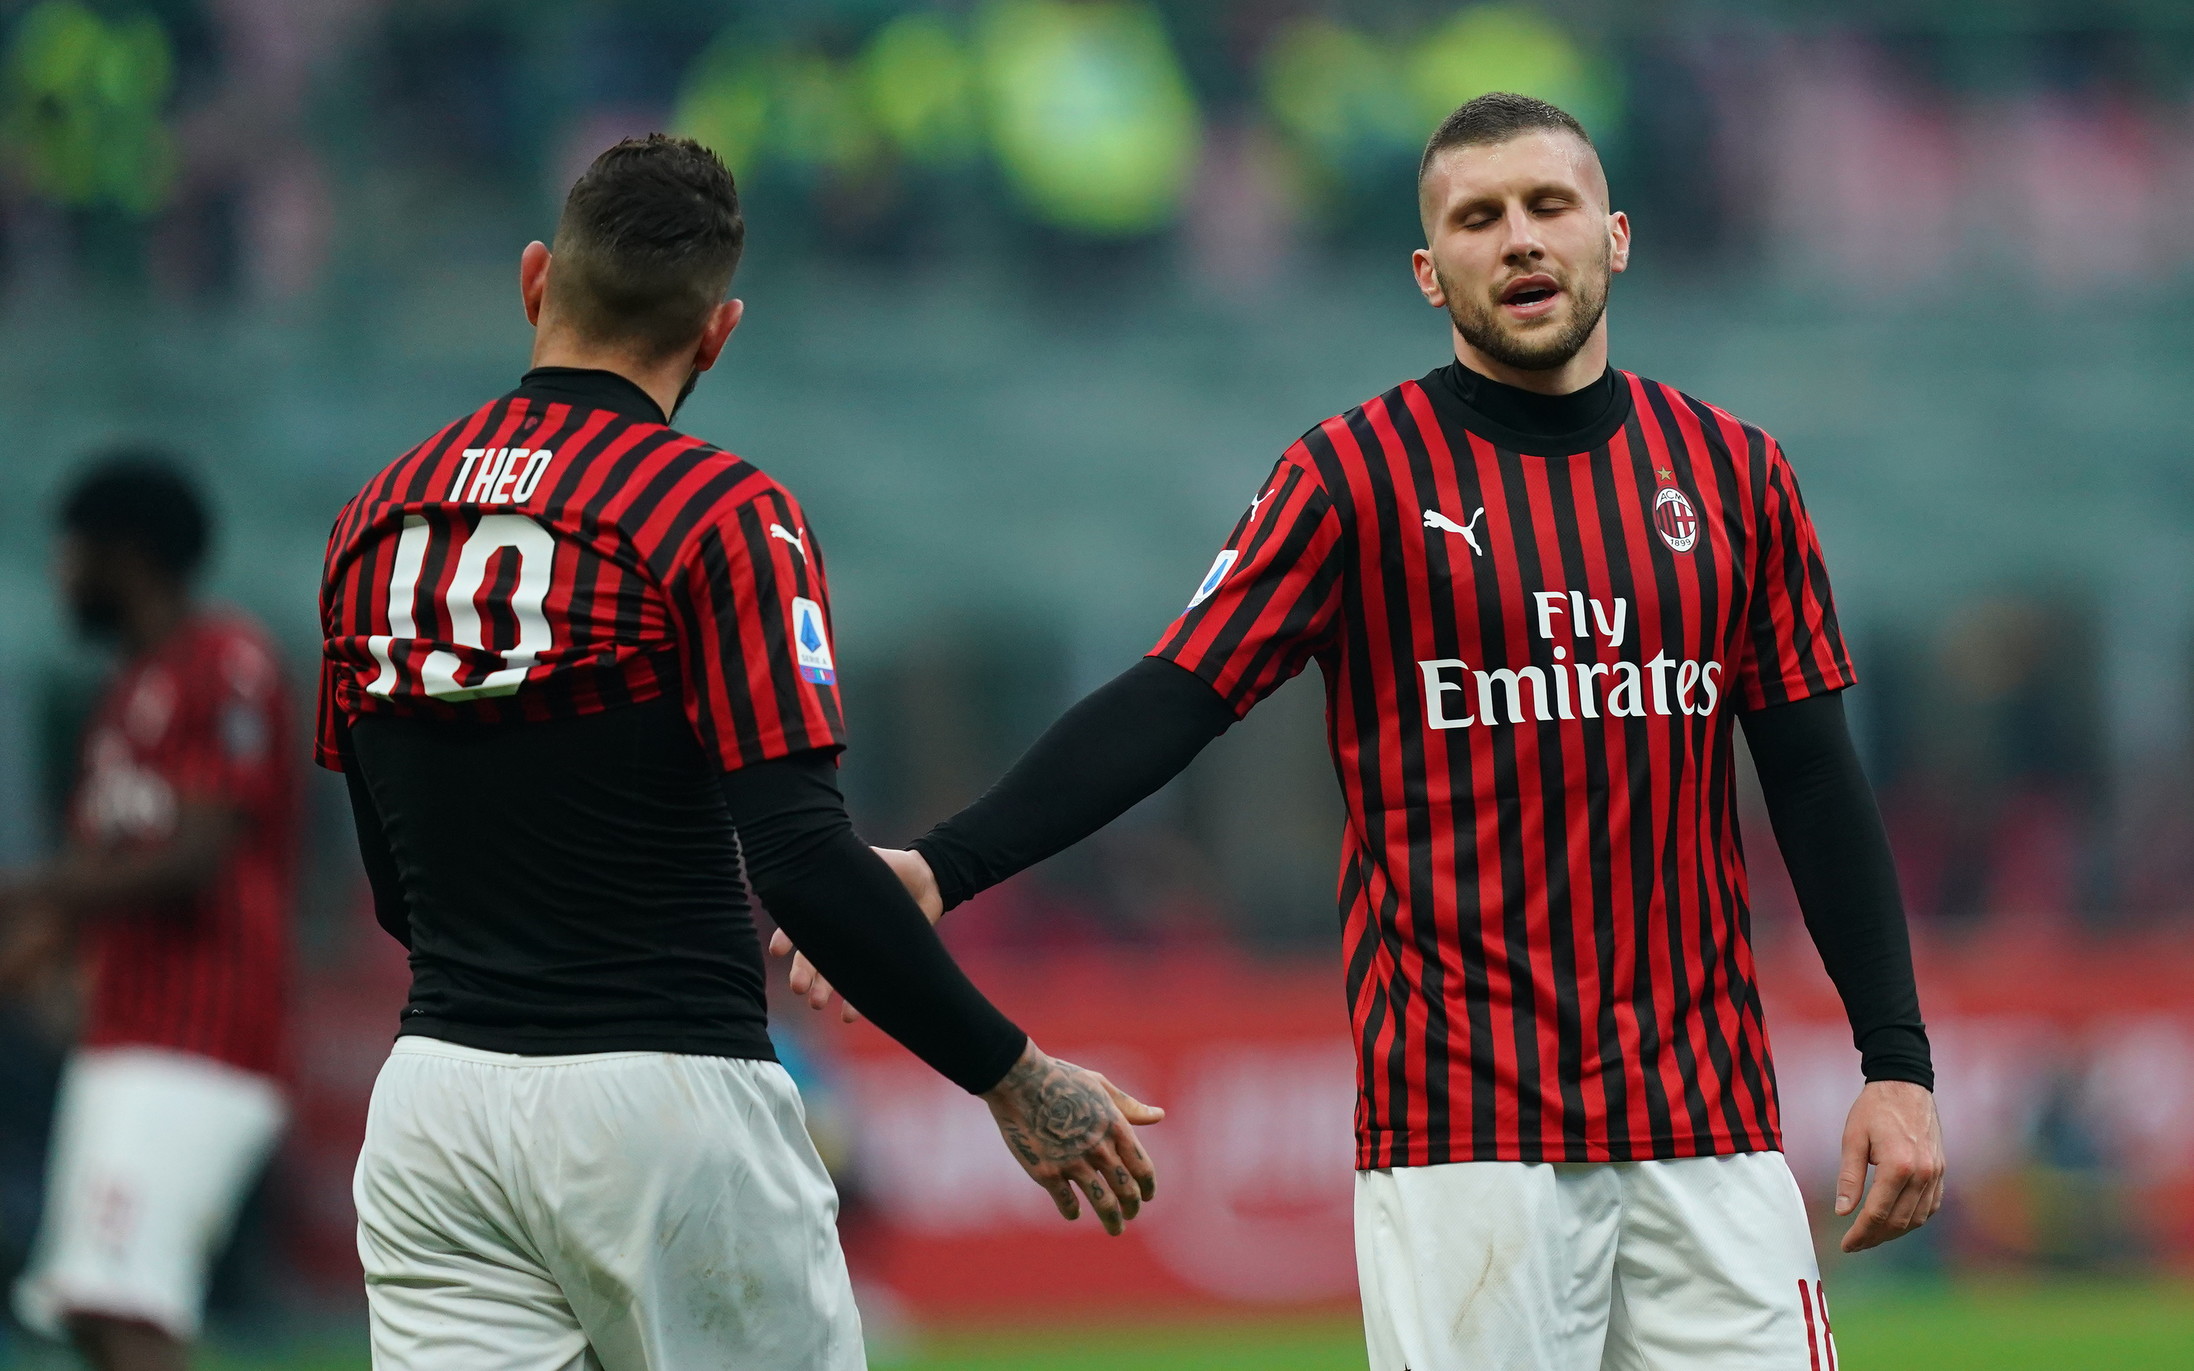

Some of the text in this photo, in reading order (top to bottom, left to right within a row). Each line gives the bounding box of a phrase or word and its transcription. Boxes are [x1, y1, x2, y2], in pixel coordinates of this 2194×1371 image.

[448, 447, 554, 504] THEO
[1660, 490, 1684, 503] ACM
[1670, 539, 1691, 547] 1899
[1532, 590, 1627, 648] Fly
[1417, 646, 1722, 730] Emirates
